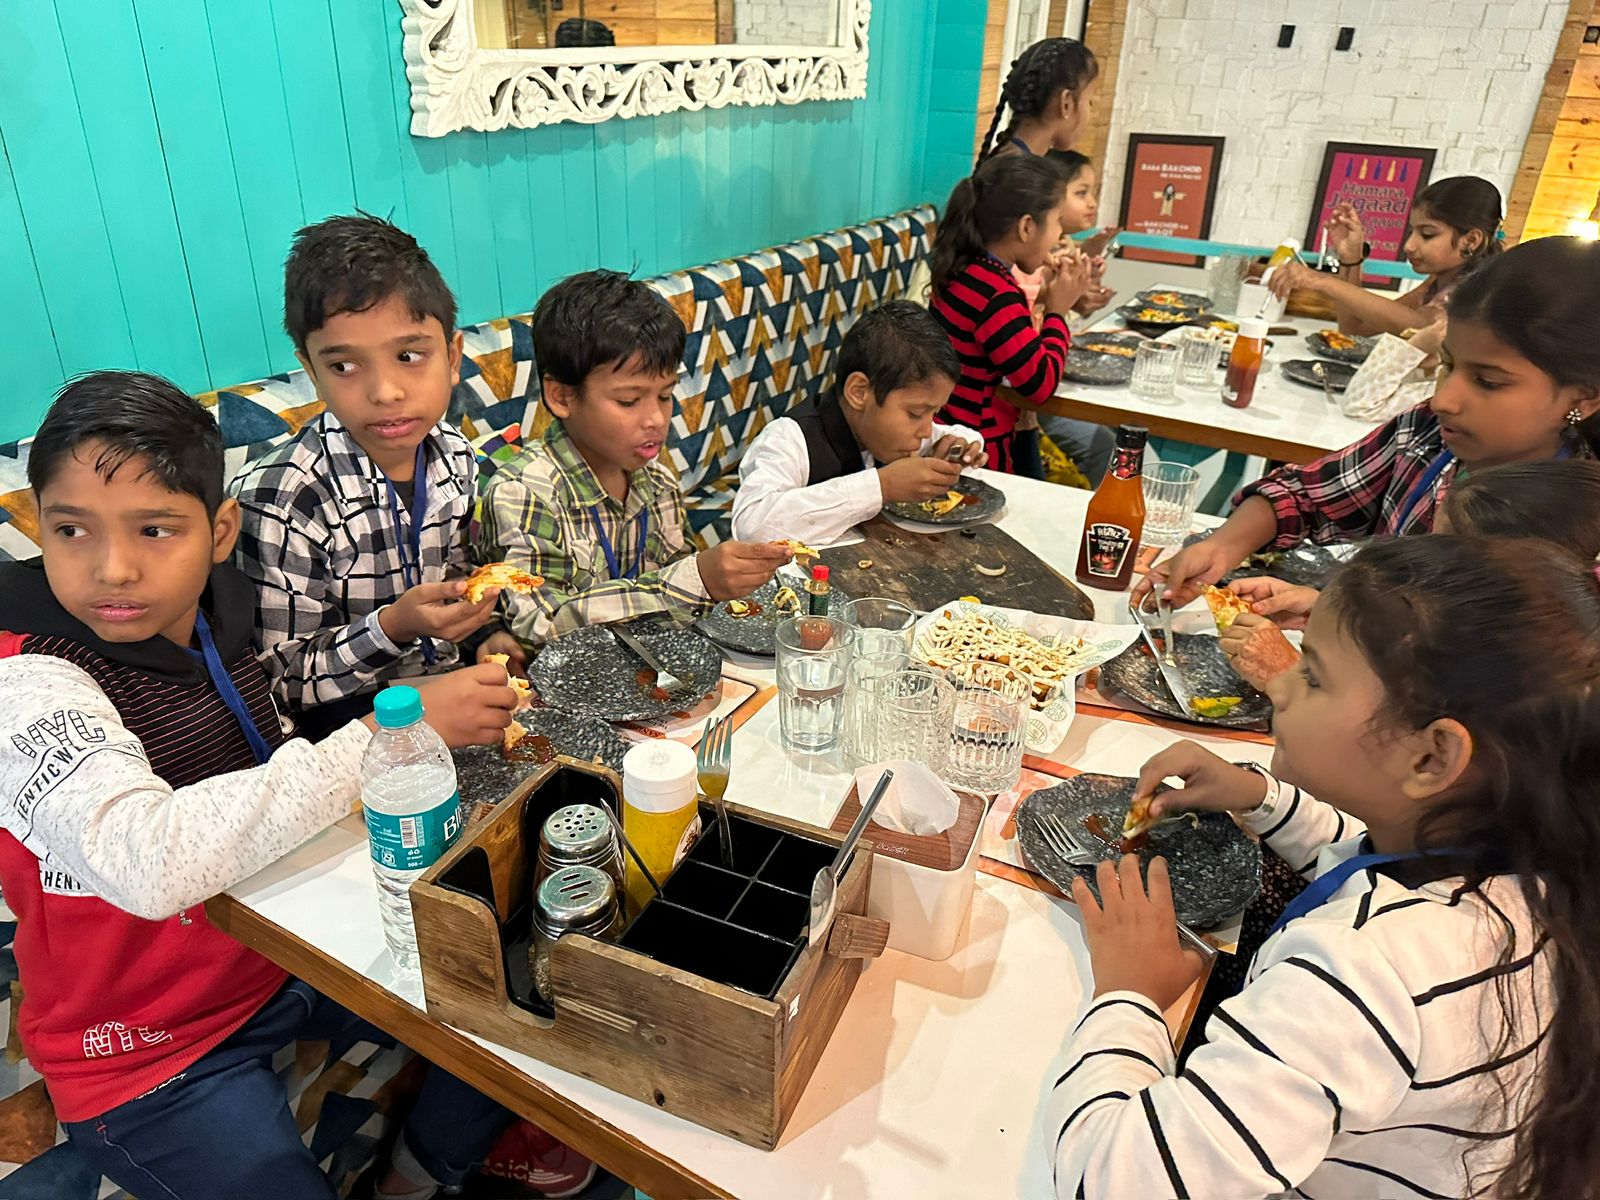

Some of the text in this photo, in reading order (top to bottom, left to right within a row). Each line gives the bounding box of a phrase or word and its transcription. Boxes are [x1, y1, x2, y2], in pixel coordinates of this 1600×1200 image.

[1342, 181, 1405, 198] Hamara
[1098, 527, 1122, 539] HEINZ
[10, 709, 106, 759] NYC
